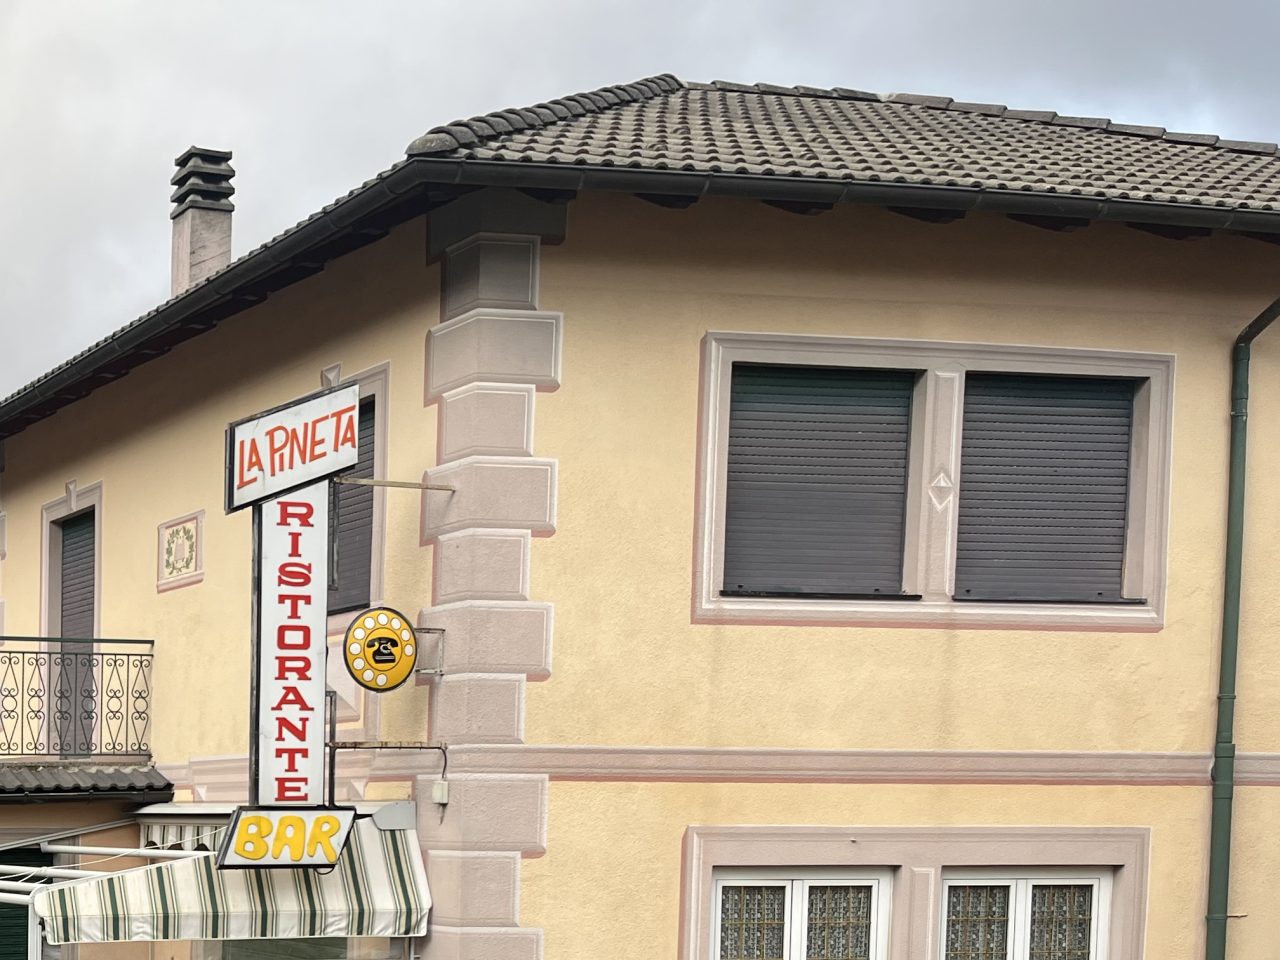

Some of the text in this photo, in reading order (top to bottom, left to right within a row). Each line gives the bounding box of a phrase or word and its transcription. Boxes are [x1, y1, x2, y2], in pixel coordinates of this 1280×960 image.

[237, 404, 357, 490] LA PINETA
[271, 501, 315, 802] RISTORANTE
[234, 815, 341, 864] BAR
